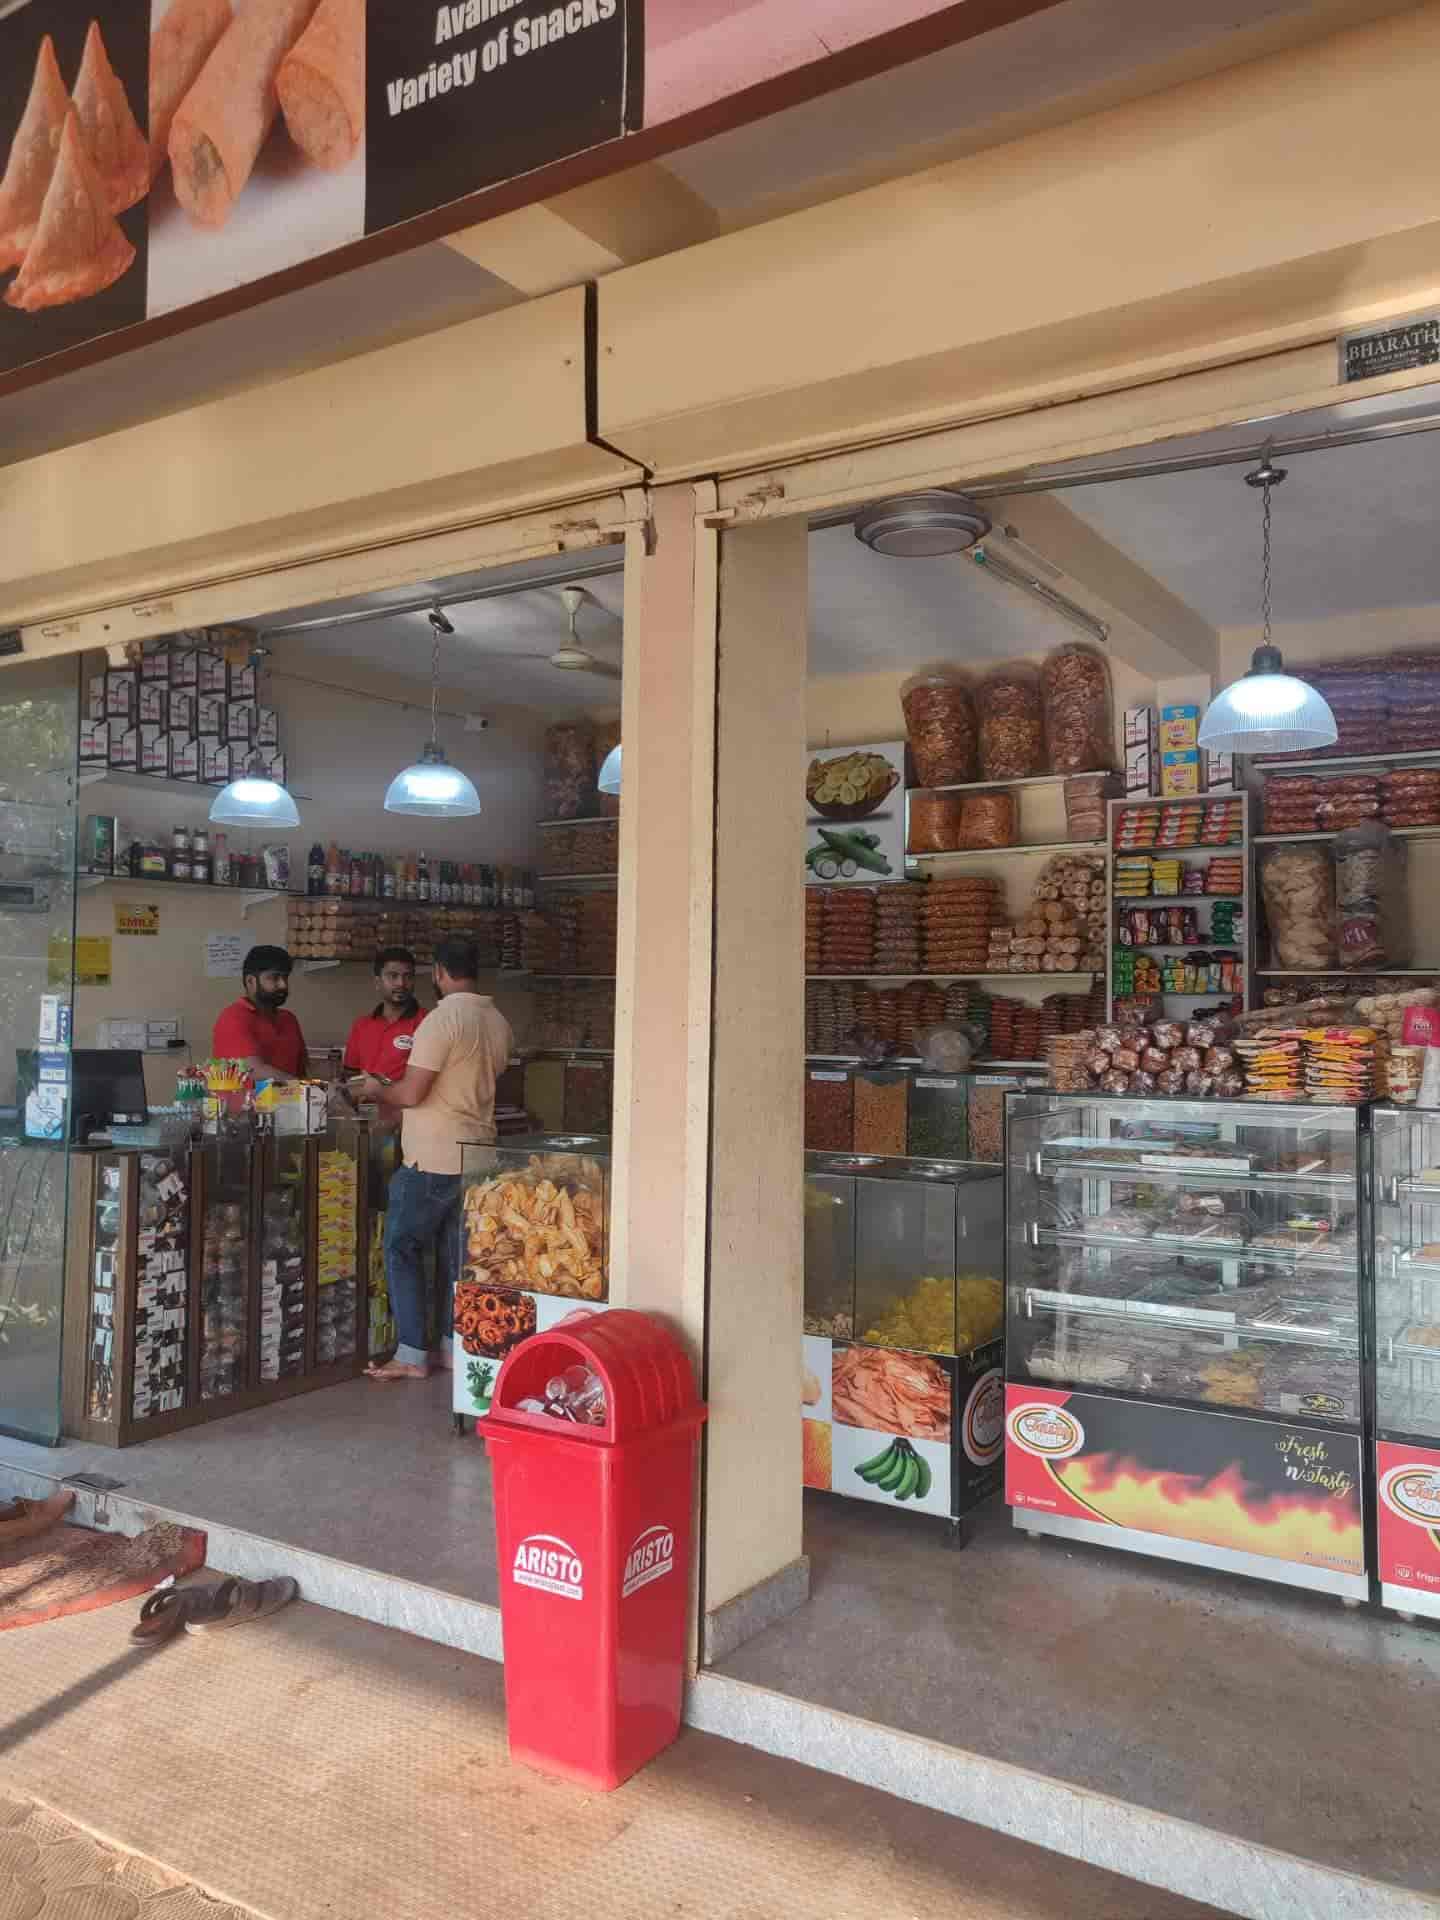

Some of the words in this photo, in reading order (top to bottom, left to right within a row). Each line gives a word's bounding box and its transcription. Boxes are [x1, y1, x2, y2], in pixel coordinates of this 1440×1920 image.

[387, 49, 477, 116] Variety
[481, 27, 509, 72] of
[513, 0, 617, 56] Snacks
[1275, 1434, 1328, 1461] Fresh
[1306, 1464, 1355, 1498] Tasty
[514, 1544, 583, 1584] ARISTO
[624, 1532, 674, 1582] ARISTO
